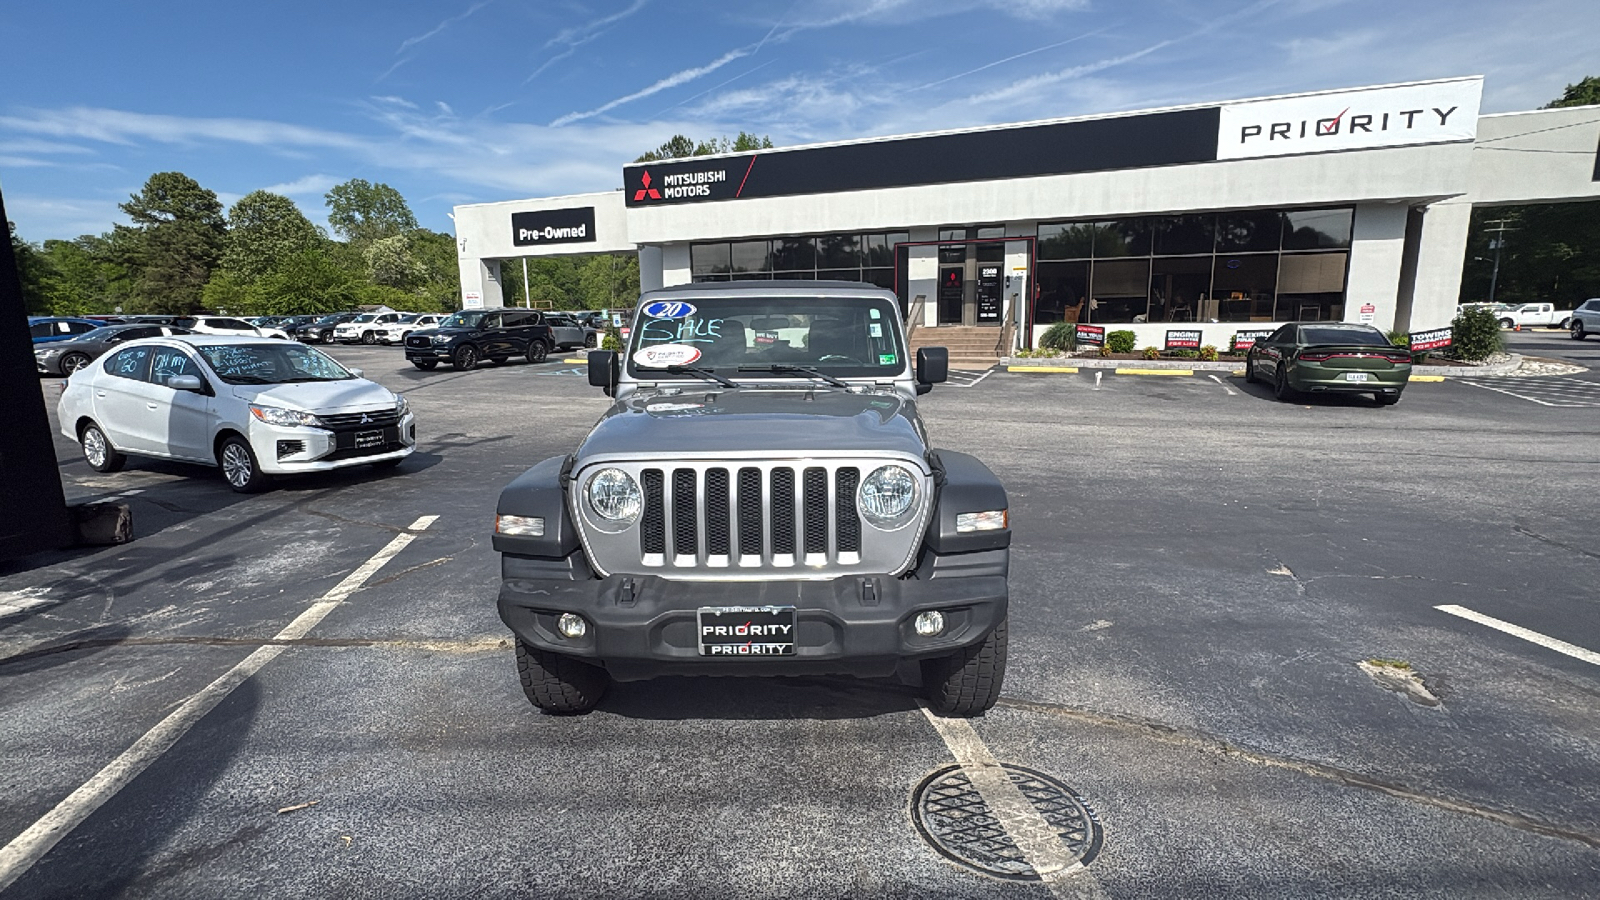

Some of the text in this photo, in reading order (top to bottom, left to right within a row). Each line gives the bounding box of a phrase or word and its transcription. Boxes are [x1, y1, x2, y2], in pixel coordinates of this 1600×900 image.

[1241, 106, 1458, 144] PRIORITY
[664, 170, 726, 187] MITSUBISHI
[664, 185, 711, 199] MOTORS
[519, 223, 586, 241] Pre-Owned
[656, 302, 683, 317] 20
[642, 318, 724, 341] SALE
[1411, 330, 1452, 341] TOWING
[702, 623, 792, 636] PRIORITY
[711, 644, 787, 654] PRIORITY
